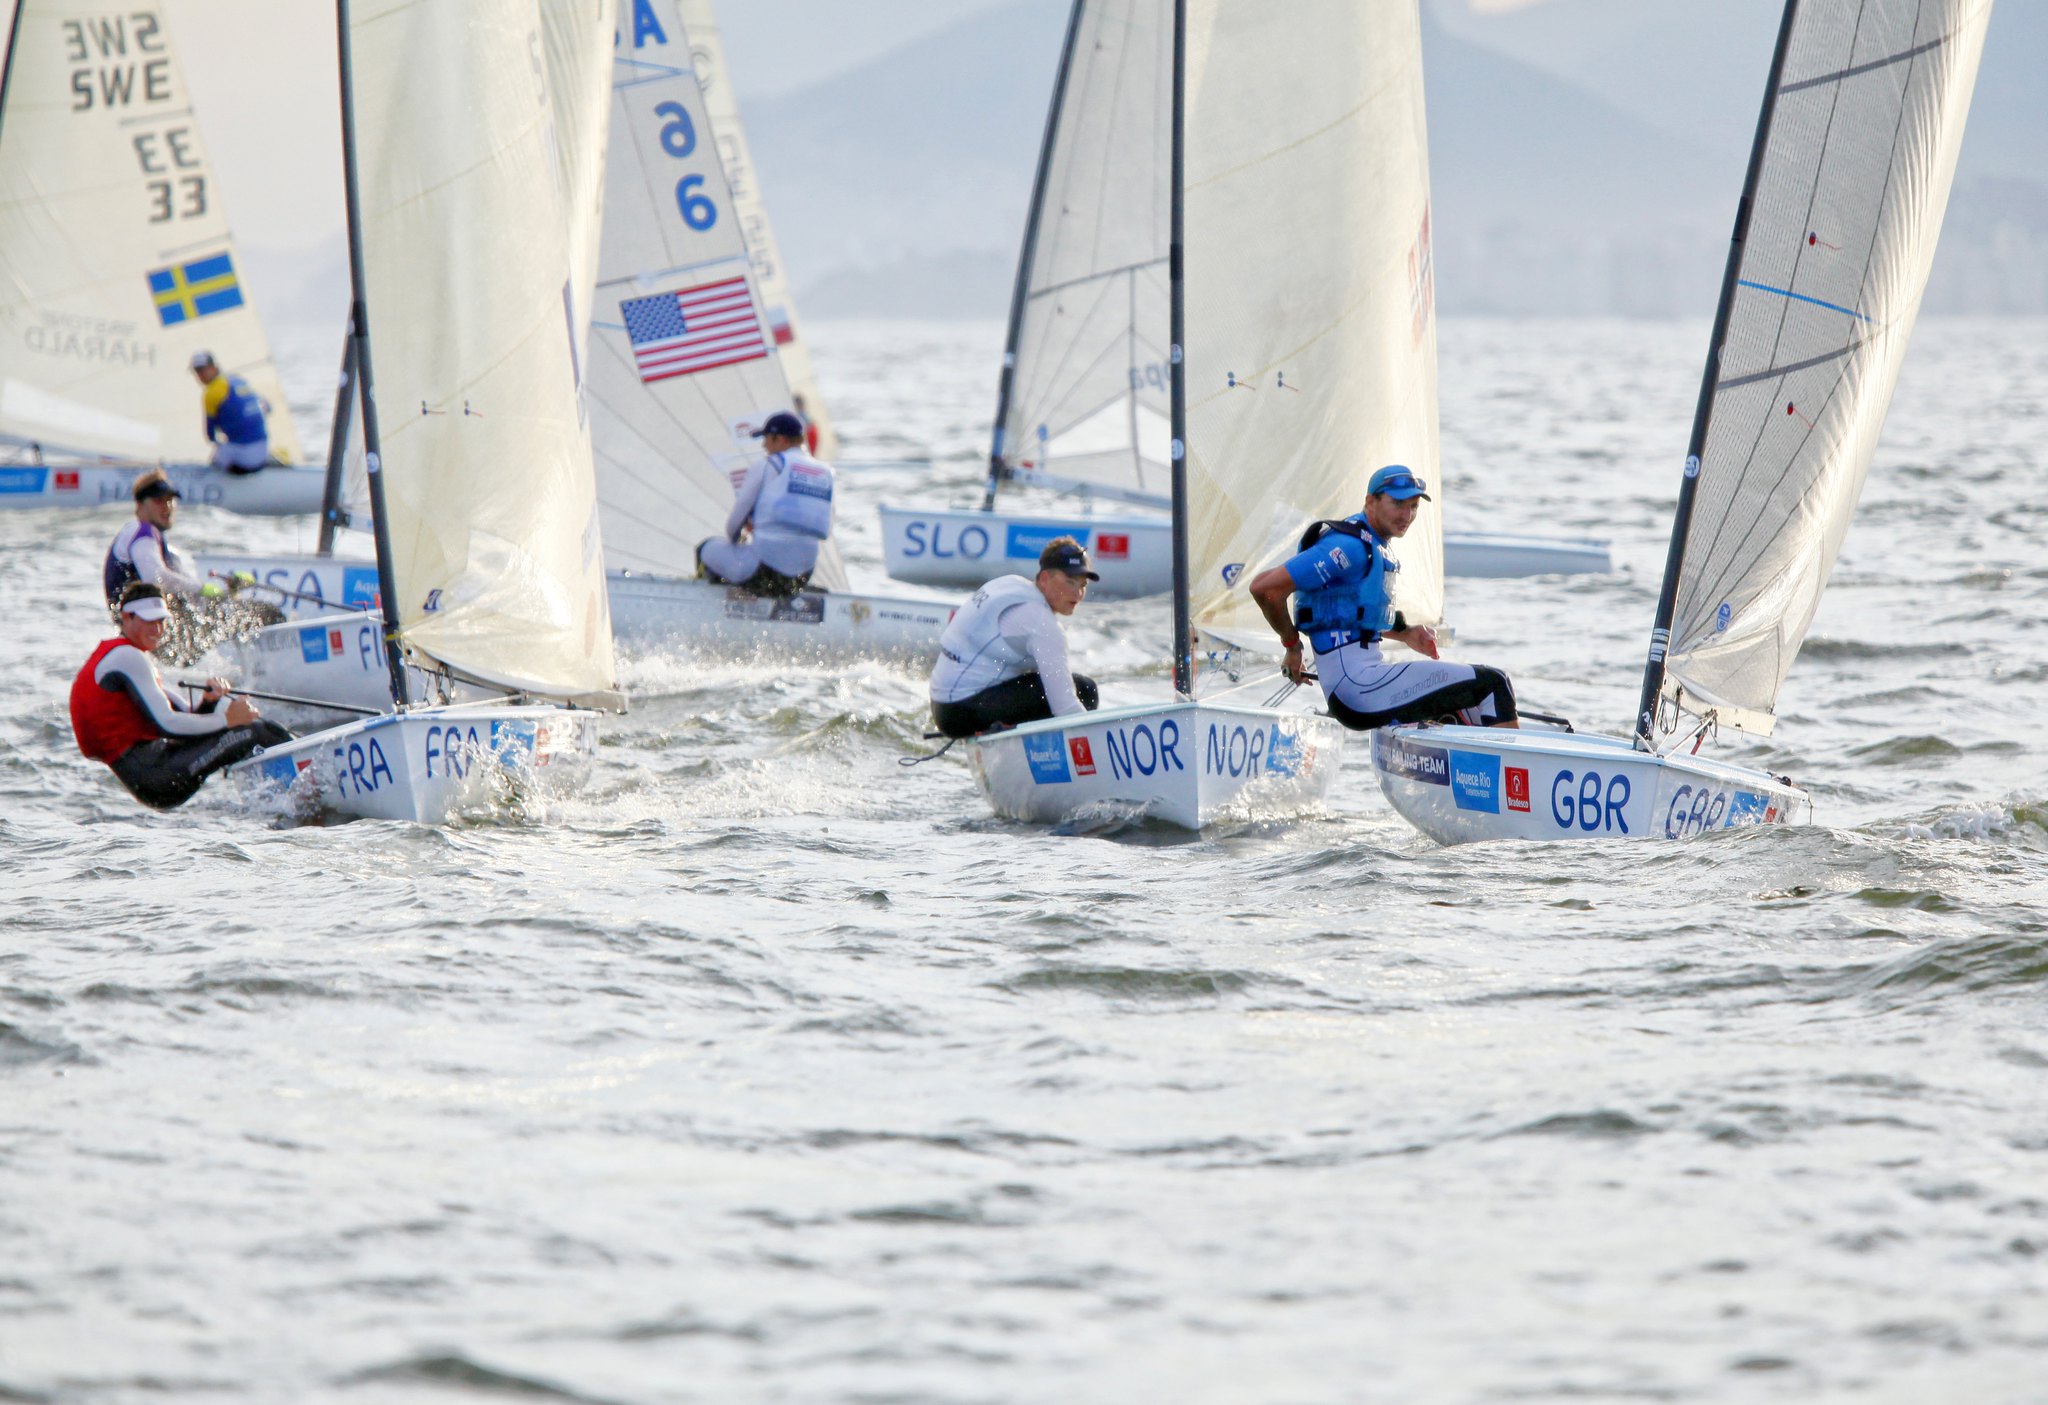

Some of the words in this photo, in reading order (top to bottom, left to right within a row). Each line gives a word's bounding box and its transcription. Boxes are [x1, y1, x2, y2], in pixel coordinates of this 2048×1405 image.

[71, 58, 172, 112] SWE
[146, 175, 208, 224] 33
[675, 173, 718, 232] 6
[903, 521, 990, 560] SLO
[333, 736, 394, 799] FRA
[426, 725, 481, 780] FRA
[1106, 719, 1184, 781] NOR
[1206, 723, 1265, 780] NOR
[1419, 756, 1446, 776] TEAM
[1455, 768, 1479, 789] Aquece
[1479, 771, 1491, 788] Rio
[1507, 796, 1529, 809] Bradesco
[1551, 769, 1631, 834] GBR
[1665, 784, 1726, 840] GBR
